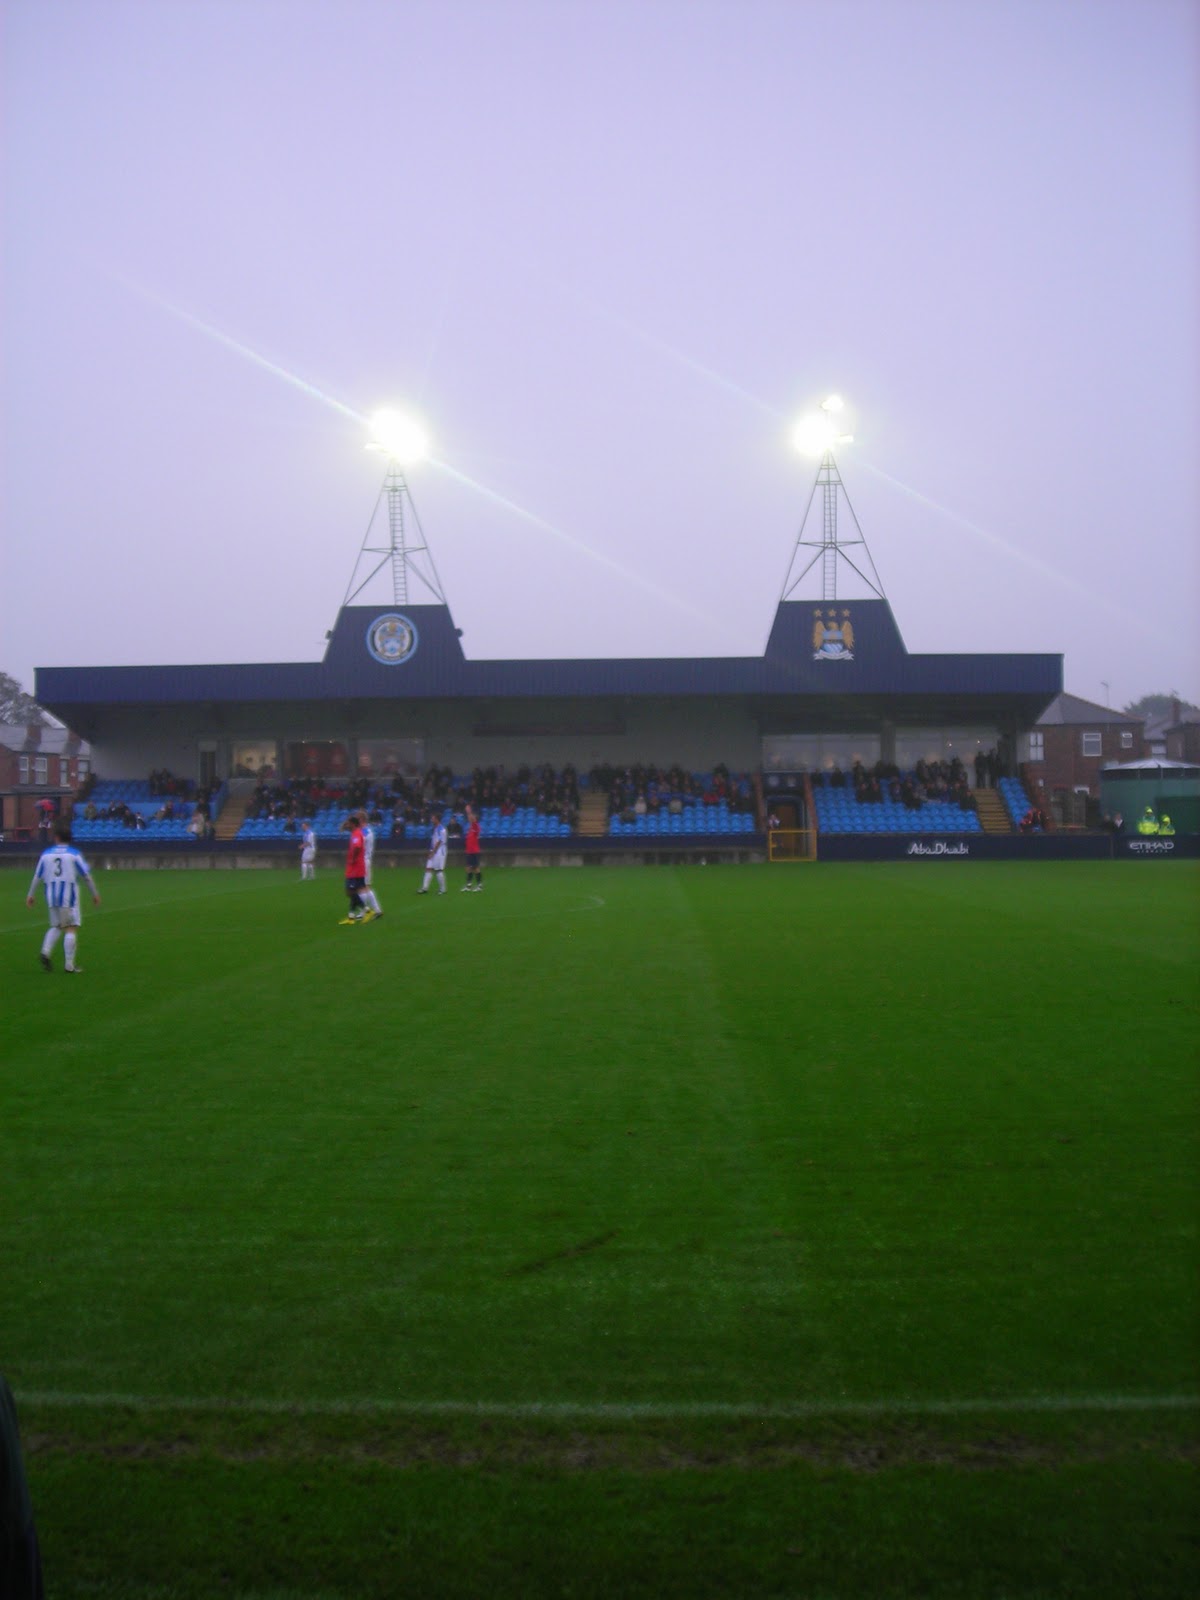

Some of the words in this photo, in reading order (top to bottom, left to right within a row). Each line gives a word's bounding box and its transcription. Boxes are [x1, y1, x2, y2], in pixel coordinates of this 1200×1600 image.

[908, 843, 932, 854] Abu
[935, 842, 969, 854] Dhabi
[1130, 842, 1174, 850] ETIHAD
[55, 857, 62, 877] 3
